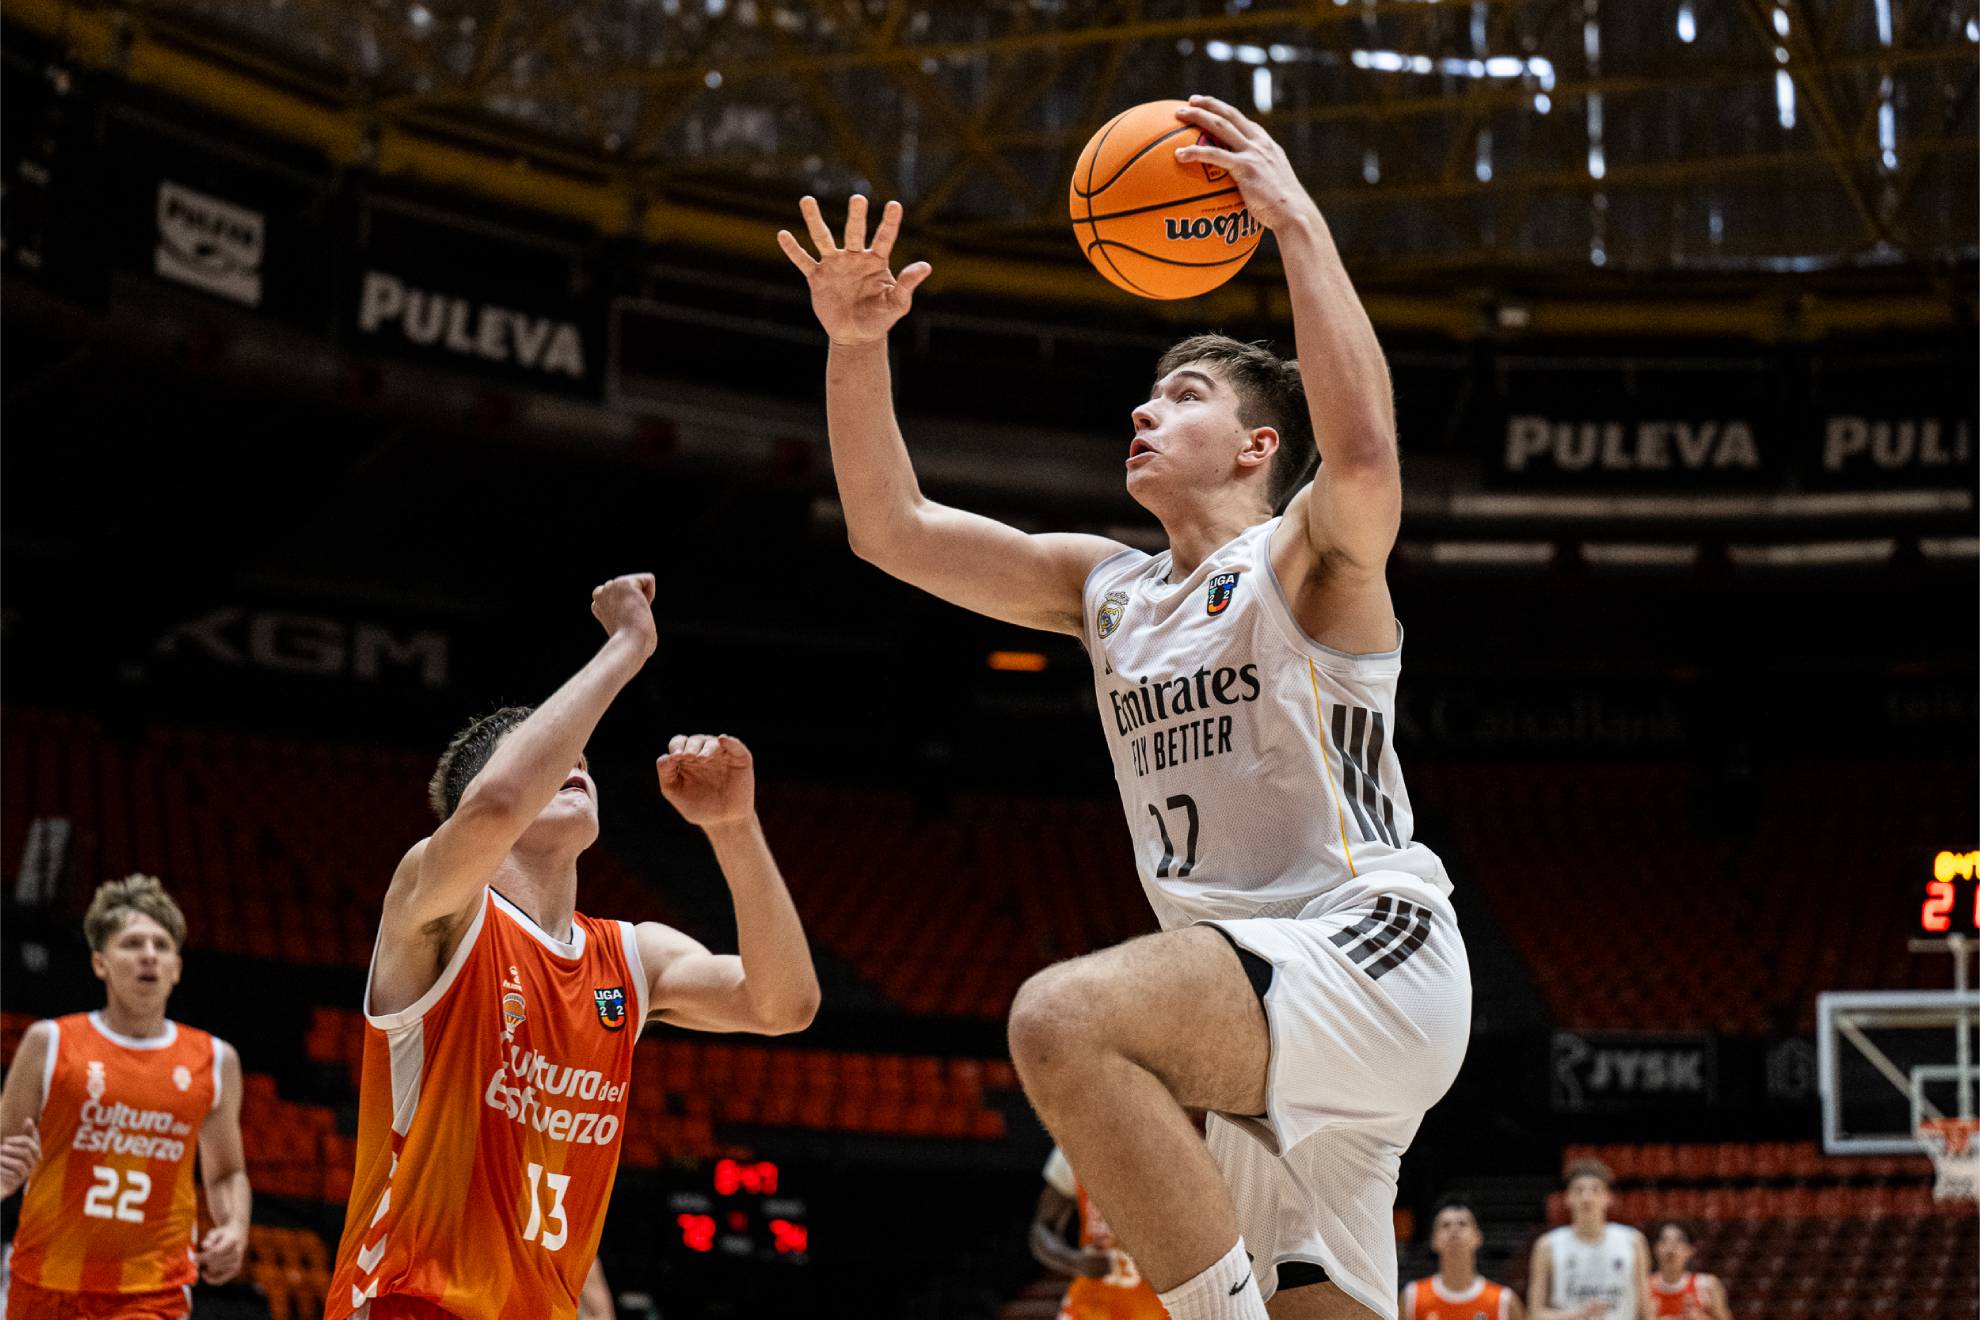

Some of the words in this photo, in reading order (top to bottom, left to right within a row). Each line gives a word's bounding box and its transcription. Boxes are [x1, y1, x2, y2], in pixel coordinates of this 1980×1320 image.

[359, 270, 585, 378] PULEVA
[1505, 415, 1759, 472] PULEVA
[1210, 574, 1236, 589] LIGA
[1109, 663, 1261, 737] Emirates
[1153, 715, 1233, 771] BETTER
[1921, 881, 1979, 932] 2
[594, 989, 623, 1000] LIGA
[80, 1100, 174, 1132] Cultura
[485, 1067, 619, 1146] Esfuerzo
[598, 1081, 627, 1103] del
[72, 1122, 185, 1162] Esfuerzo
[83, 1165, 152, 1224] 22
[523, 1162, 571, 1252] 13
